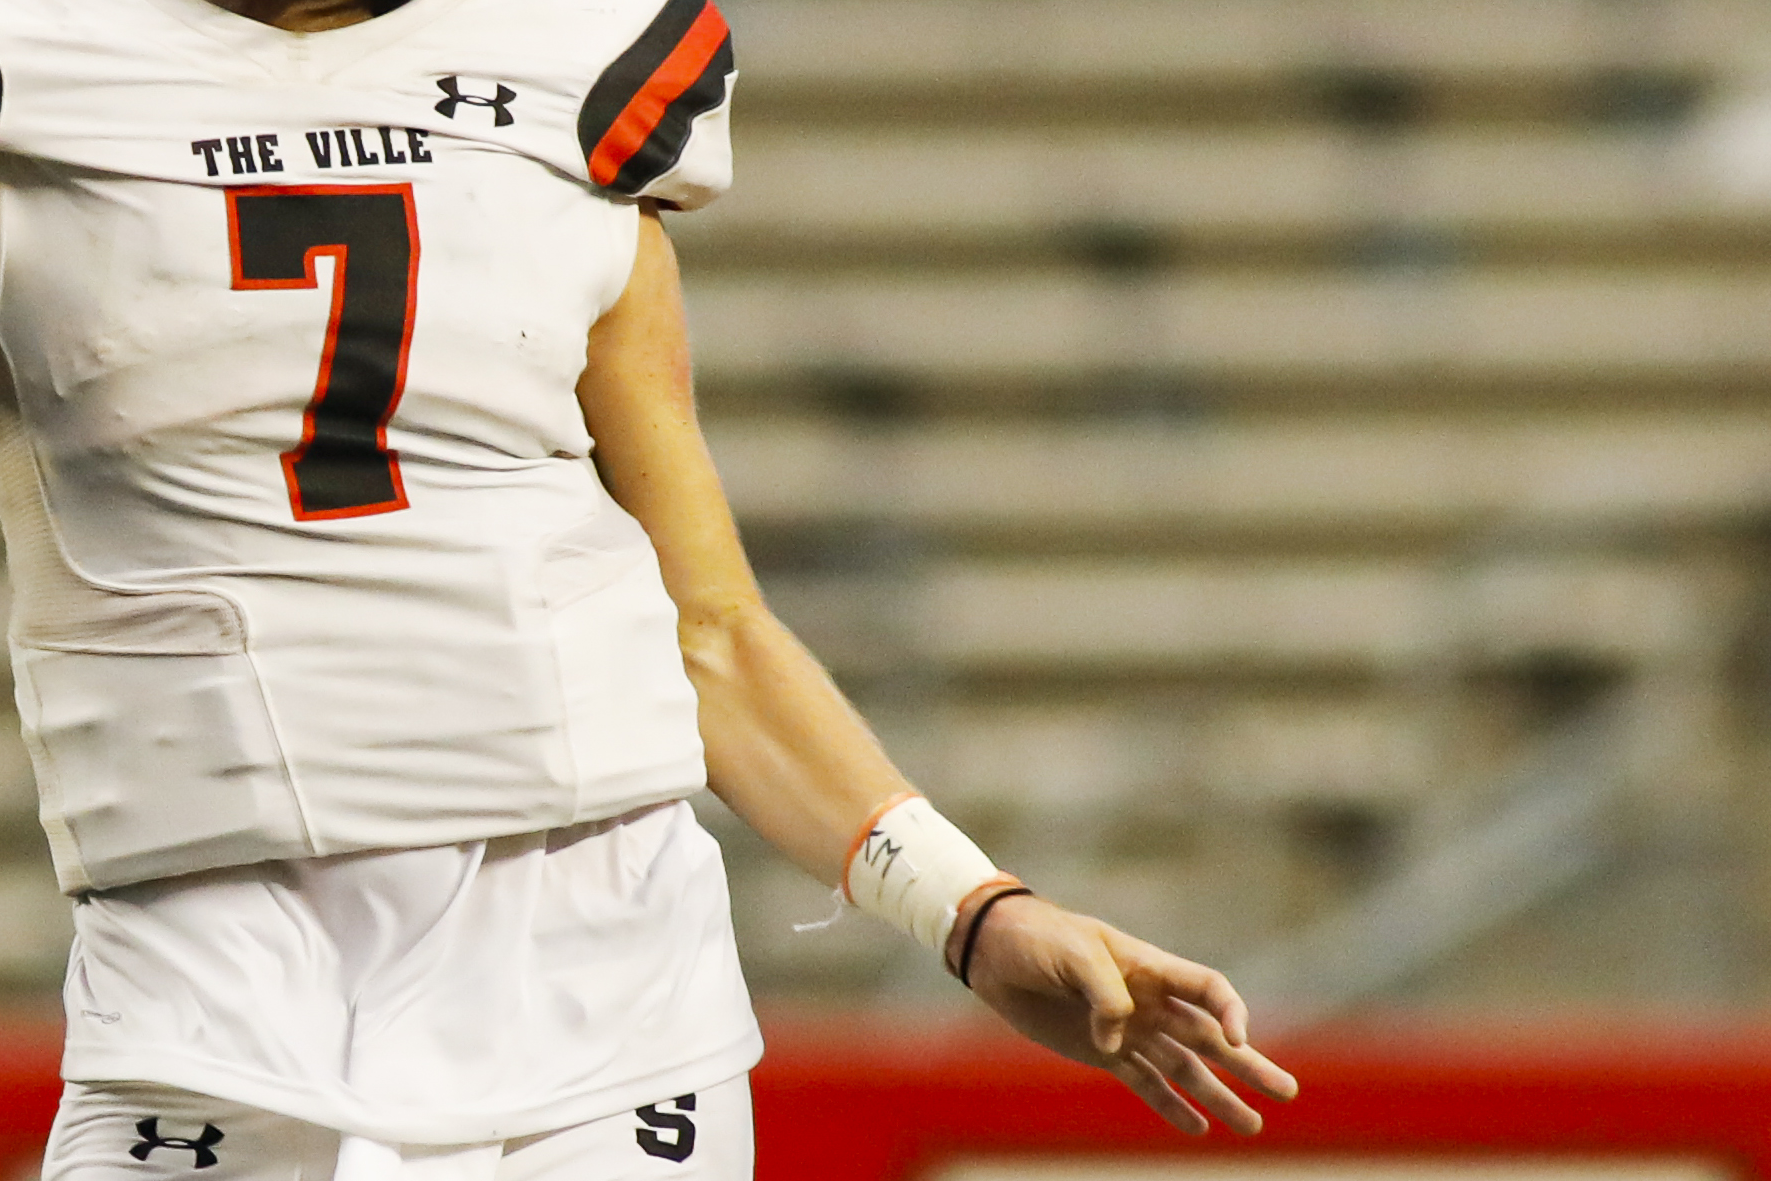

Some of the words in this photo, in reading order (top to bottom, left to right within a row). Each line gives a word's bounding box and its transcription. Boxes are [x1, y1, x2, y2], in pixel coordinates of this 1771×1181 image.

[191, 134, 284, 177] THE
[305, 126, 433, 170] VILLE
[224, 182, 421, 522] 7
[634, 1092, 697, 1163] S
